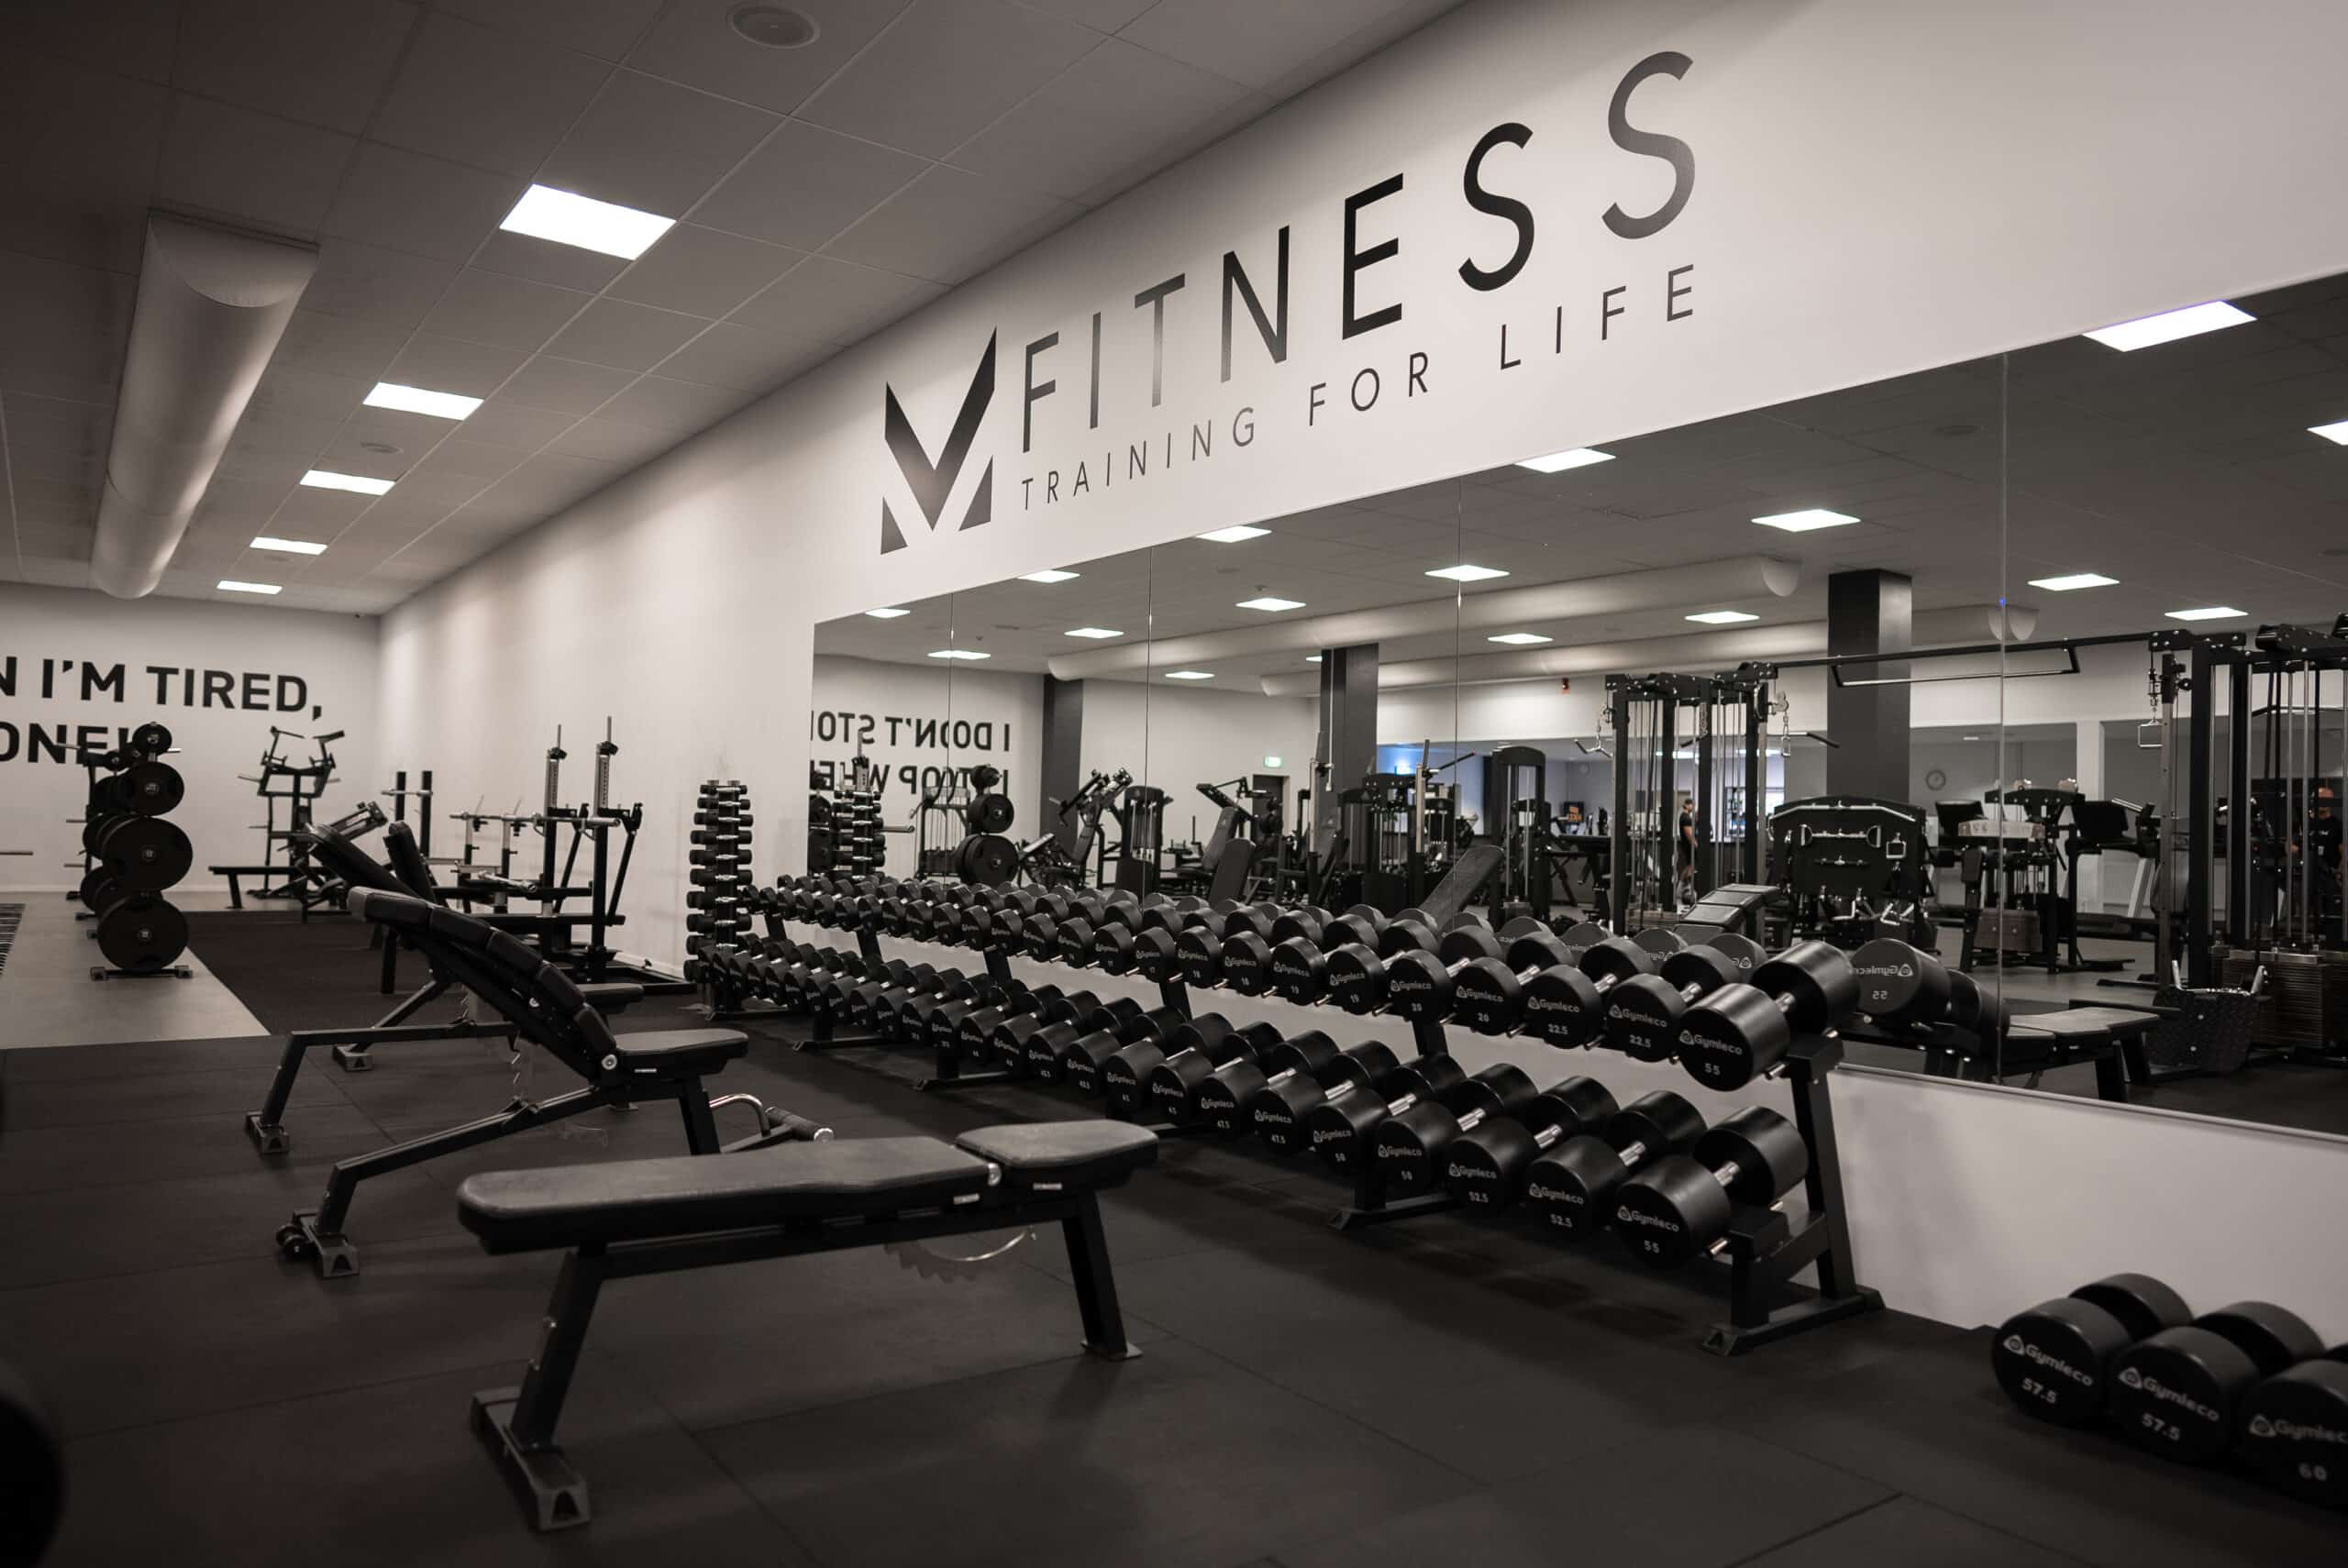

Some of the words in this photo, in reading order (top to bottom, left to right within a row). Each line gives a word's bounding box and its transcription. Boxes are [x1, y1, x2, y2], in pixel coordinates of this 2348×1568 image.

[1022, 50, 1697, 454] FITNESS
[1021, 406, 1256, 511] TRAINING
[1309, 351, 1429, 427] FOR
[1500, 263, 1696, 370] LIFE
[41, 658, 126, 703] I'M
[145, 666, 323, 721] TIRED,
[1622, 1009, 1667, 1027] Gymleco
[1629, 1034, 1652, 1049] 22.5
[1694, 1034, 1743, 1055] Gymleco
[1704, 1064, 1721, 1076] 55
[1631, 1210, 1680, 1232] Gymleco
[1644, 1240, 1659, 1253] 55
[2025, 1343, 2094, 1387] Gymleco
[2021, 1376, 2057, 1405] 57.5
[2143, 1374, 2220, 1422] Gymleco
[2142, 1412, 2181, 1441] 57.5
